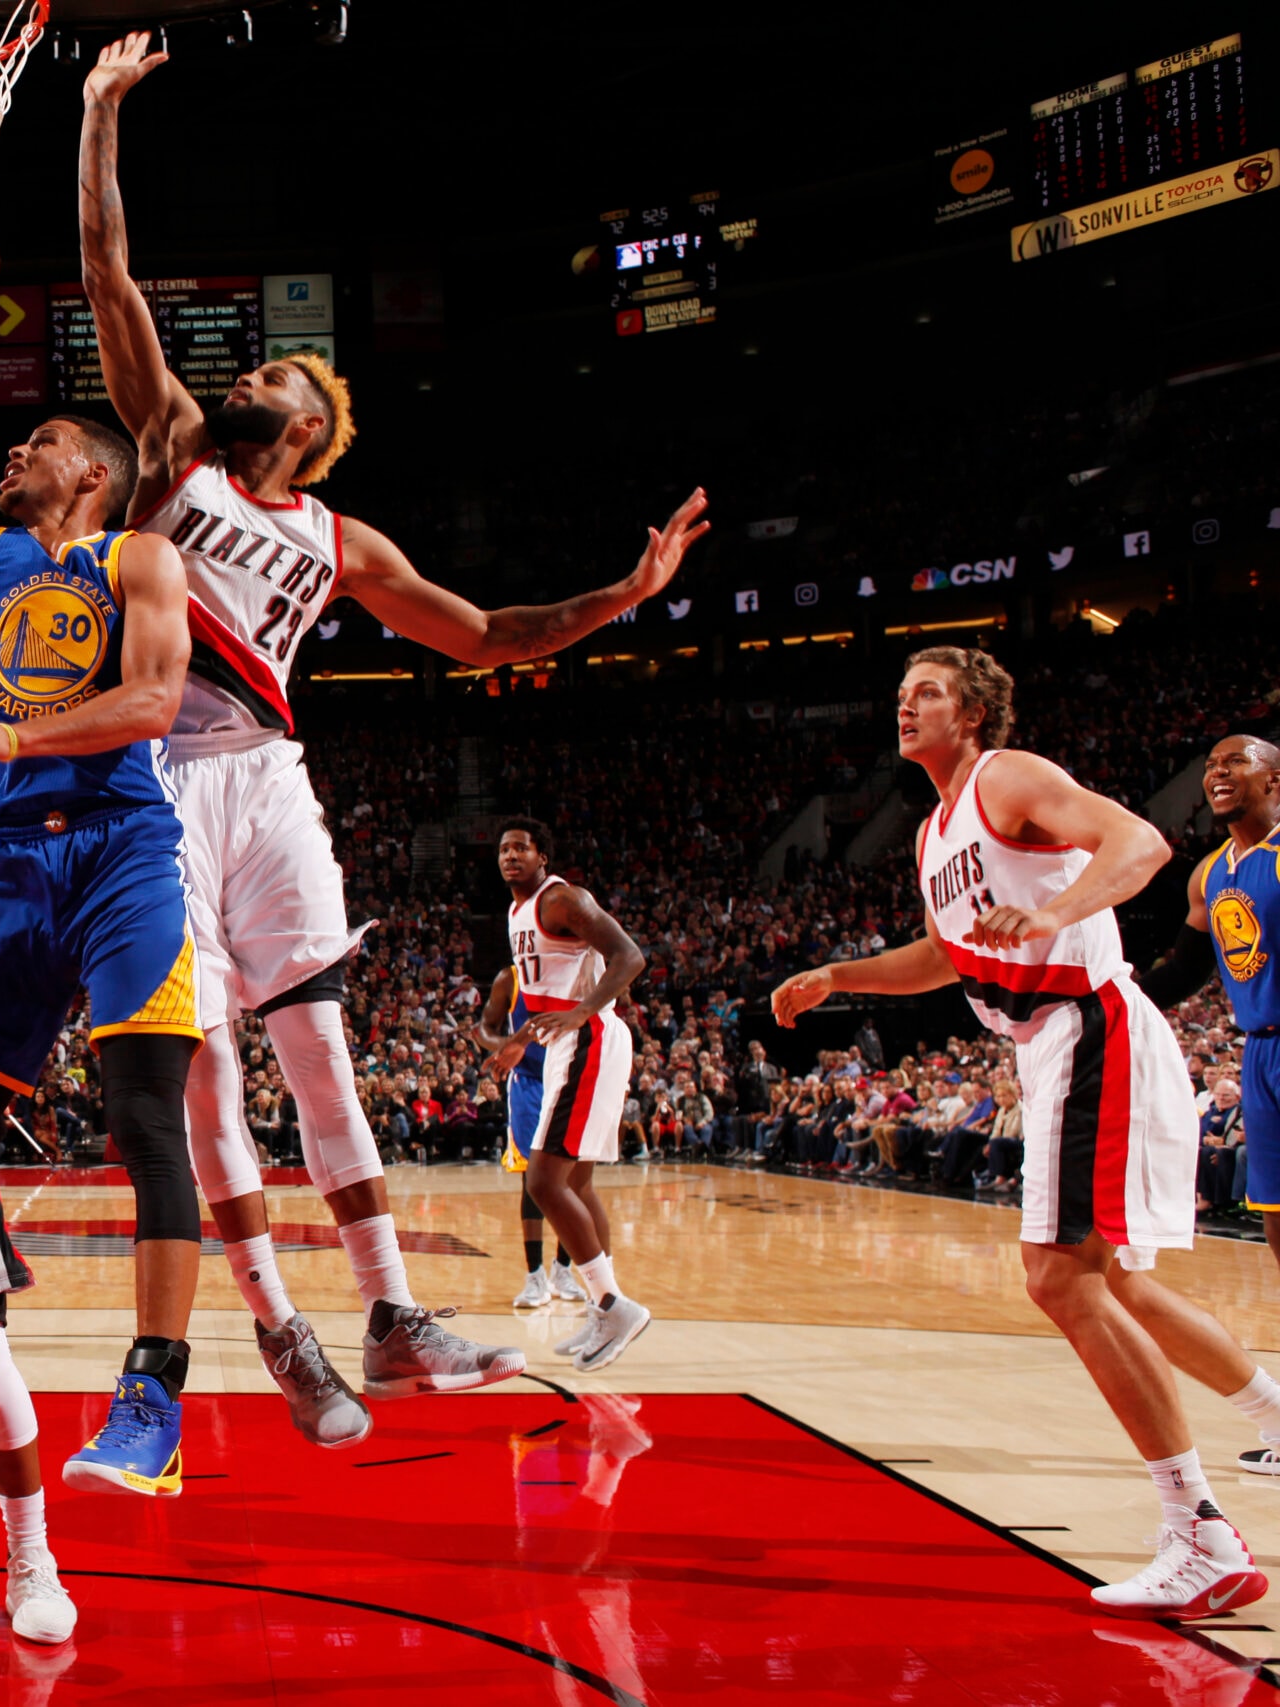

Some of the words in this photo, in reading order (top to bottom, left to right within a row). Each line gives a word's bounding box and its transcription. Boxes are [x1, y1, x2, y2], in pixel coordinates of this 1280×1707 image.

[1160, 41, 1214, 68] GUEST
[1057, 81, 1099, 103] HOME
[956, 163, 989, 181] smile
[1166, 175, 1224, 199] TOYOTA
[1035, 191, 1165, 253] WILSONVILLE
[157, 279, 200, 291] CENTRAL
[177, 306, 205, 317] POINTS
[215, 304, 238, 315] PAINT
[644, 297, 702, 318] DOWNLOAD
[11, 386, 40, 398] moda
[171, 506, 334, 605] BLAZERS
[949, 555, 1018, 587] CSN
[0, 571, 65, 608] GOLDEN
[70, 576, 116, 617] STATE
[48, 611, 92, 644] 30
[253, 594, 304, 663] 23
[1234, 911, 1243, 930] 3
[519, 954, 541, 986] 17
